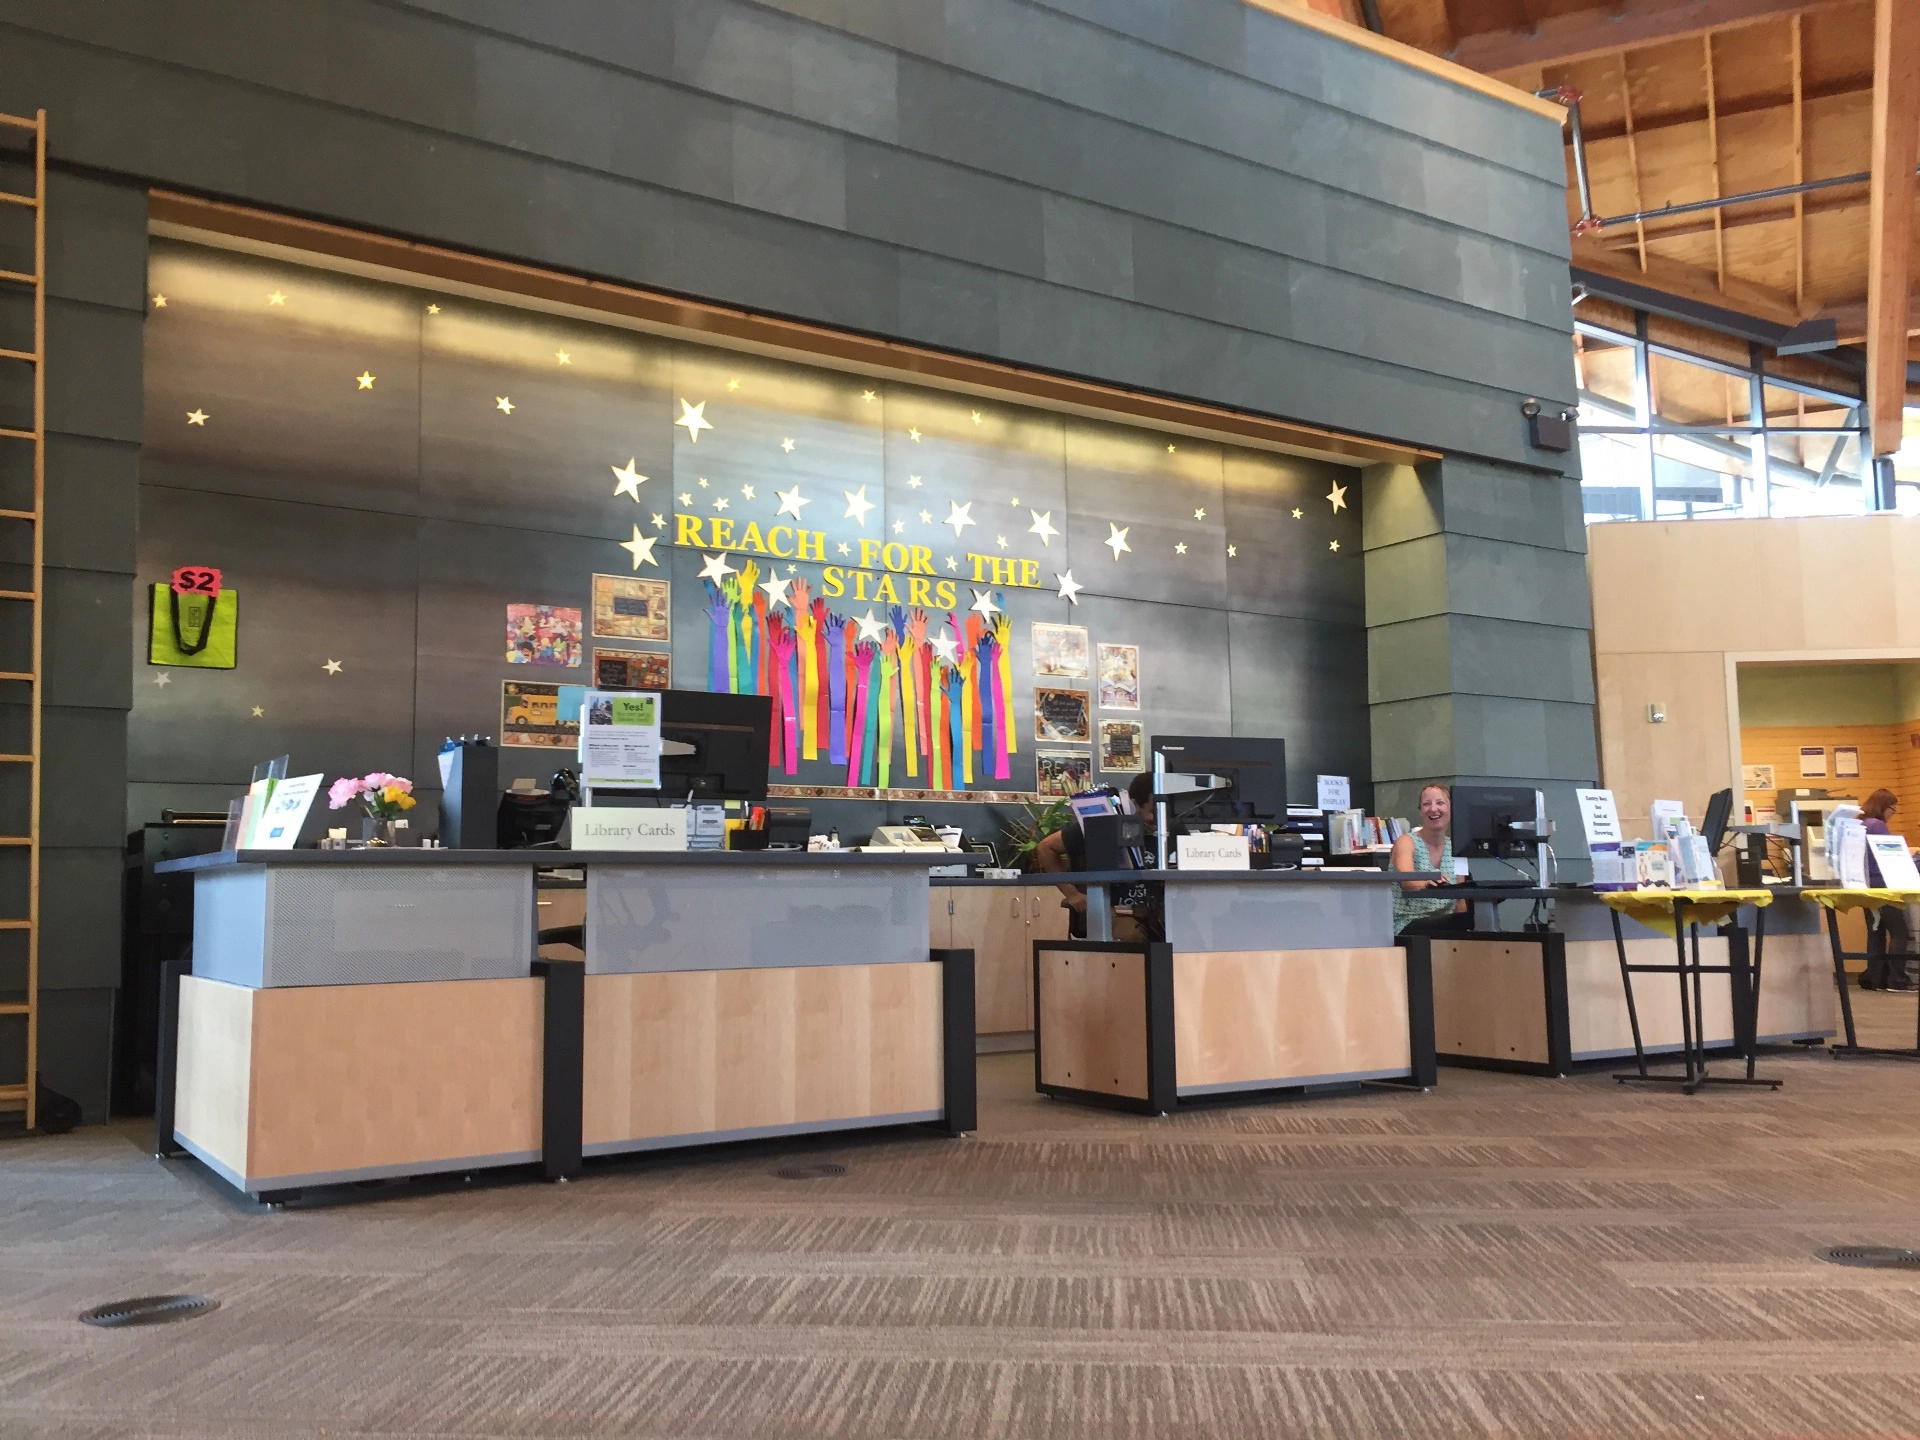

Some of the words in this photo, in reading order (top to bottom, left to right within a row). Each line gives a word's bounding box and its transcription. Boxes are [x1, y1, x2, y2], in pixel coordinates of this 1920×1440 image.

[674, 513, 828, 562] REACH
[858, 538, 938, 575] FOR
[966, 552, 1042, 588] THE
[822, 566, 957, 610] STARS
[623, 702, 644, 711] Yes!
[584, 823, 634, 840] Library
[637, 822, 676, 837] Cards
[1186, 847, 1216, 860] Library
[1217, 848, 1242, 859] Cards
